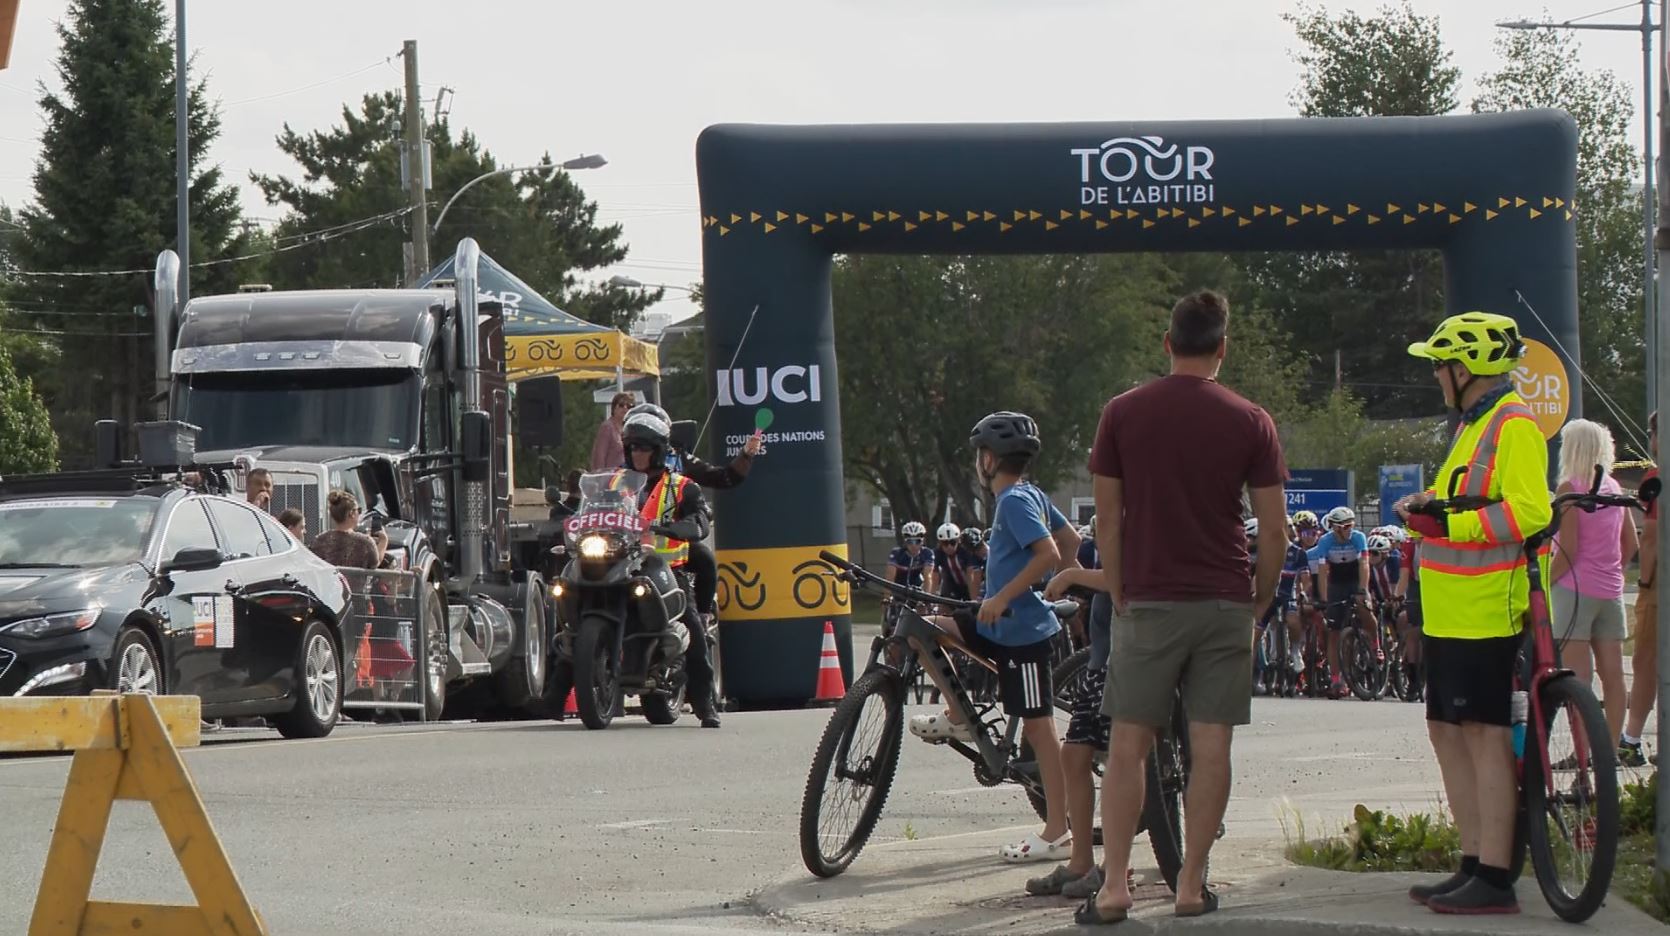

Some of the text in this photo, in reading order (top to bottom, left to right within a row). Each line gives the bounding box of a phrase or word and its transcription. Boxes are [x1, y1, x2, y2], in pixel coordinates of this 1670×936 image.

[1070, 136, 1214, 183] TOUR
[1081, 184, 1214, 205] DE L'ABITIBI
[1517, 366, 1561, 400] UR
[1529, 401, 1562, 415] ITIBI
[760, 432, 780, 443] DES
[782, 430, 825, 442] NATIONS
[568, 512, 643, 531] OFFICIEL
